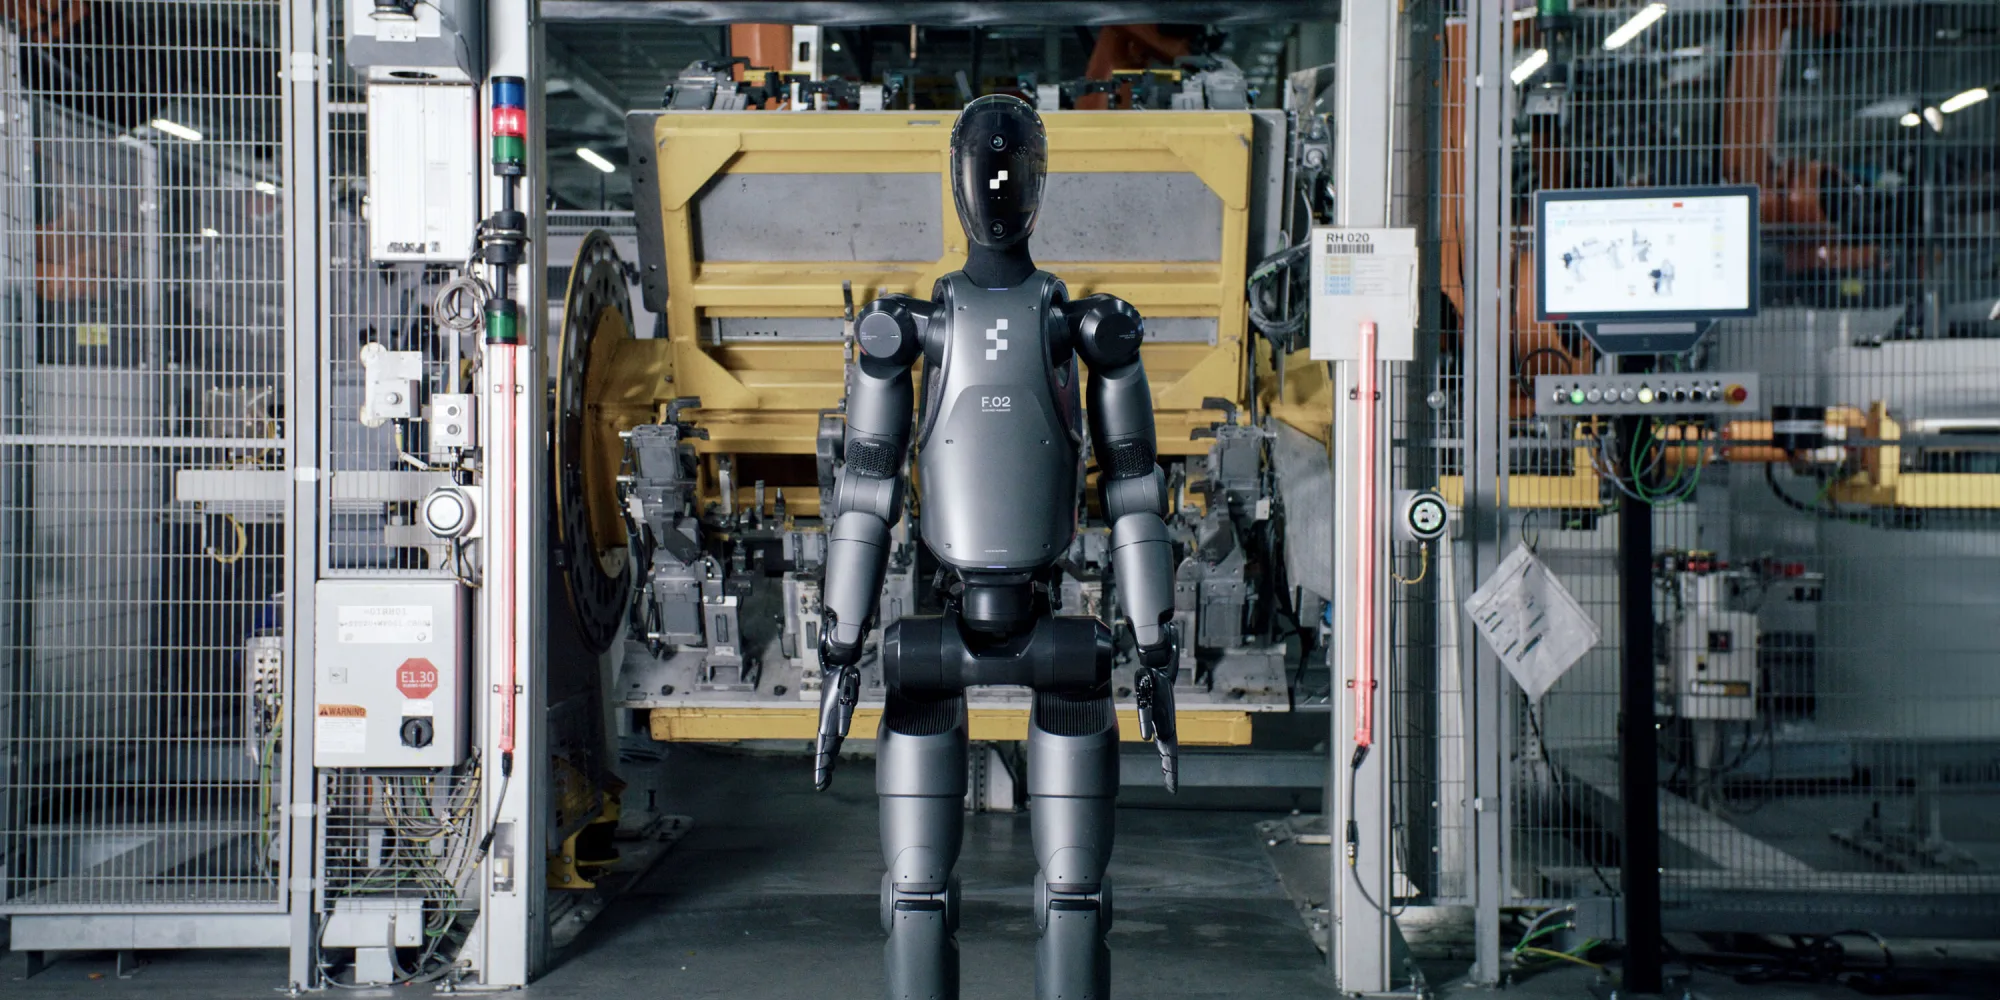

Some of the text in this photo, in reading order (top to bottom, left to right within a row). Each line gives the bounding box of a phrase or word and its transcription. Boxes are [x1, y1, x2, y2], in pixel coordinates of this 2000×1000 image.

[1326, 233, 1370, 243] RH 020
[981, 396, 1011, 408] F.02
[401, 671, 435, 683] E1.30
[328, 707, 366, 717] WARNING
